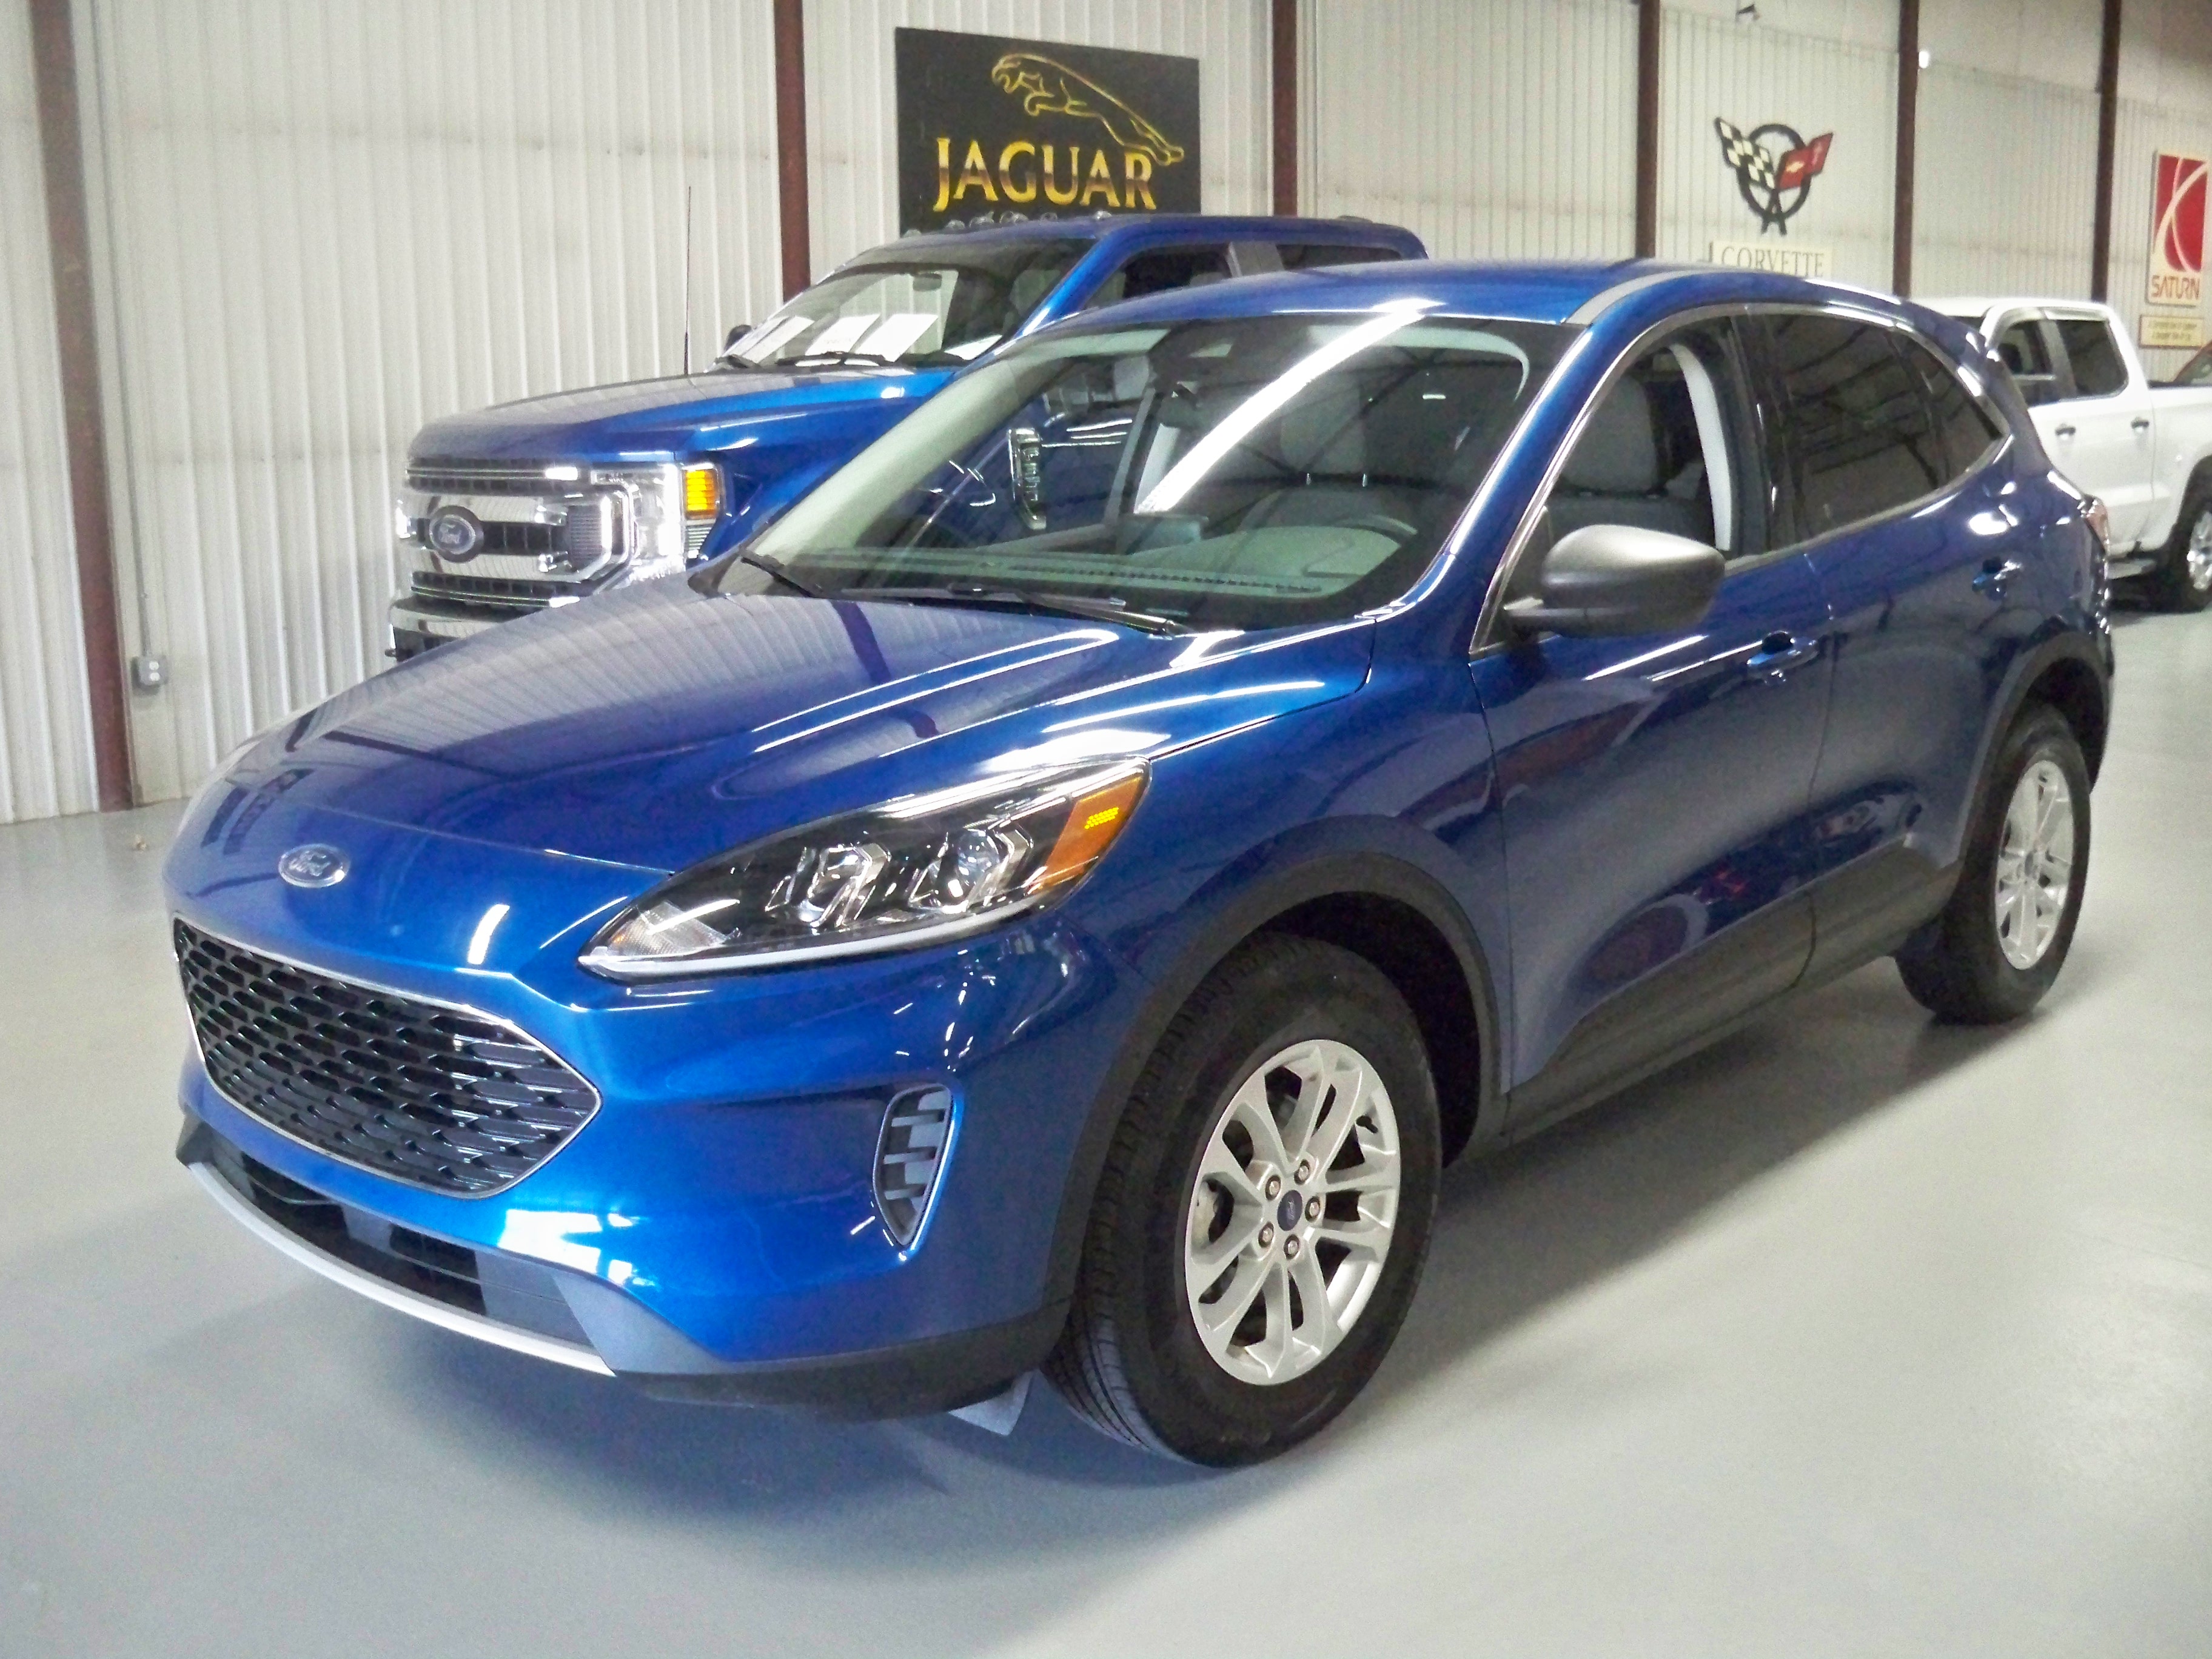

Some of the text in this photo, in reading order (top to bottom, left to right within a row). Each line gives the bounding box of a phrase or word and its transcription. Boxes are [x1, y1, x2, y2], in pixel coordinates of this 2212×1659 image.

[933, 136, 1157, 212] JAGUAR
[1721, 246, 1825, 278] CORVETTE
[2151, 275, 2200, 300] SATURN
[438, 523, 462, 545] Ford
[288, 850, 332, 877] Ford
